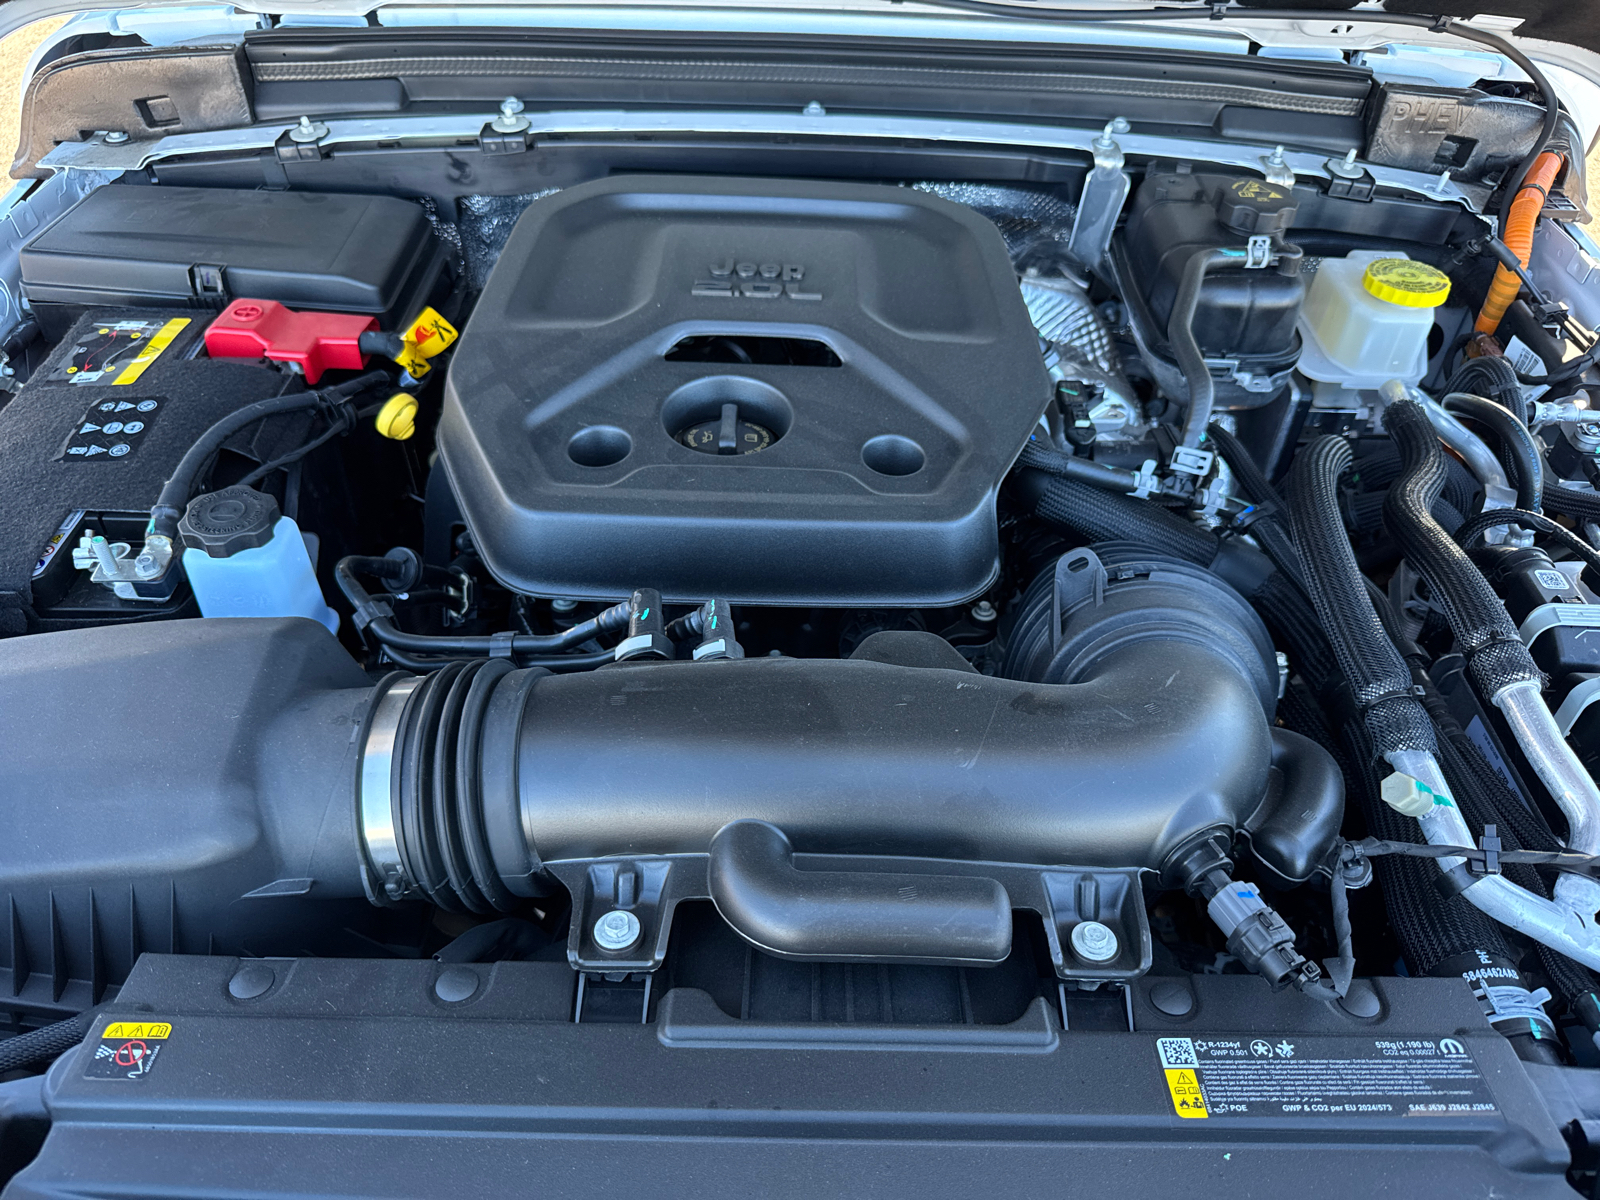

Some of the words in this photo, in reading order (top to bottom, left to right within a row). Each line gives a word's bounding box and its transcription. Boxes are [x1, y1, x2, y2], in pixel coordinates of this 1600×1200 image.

[1384, 101, 1476, 134] PHEV
[709, 259, 805, 280] Jeep
[1518, 431, 1530, 446] HOSE
[1408, 1104, 1427, 1112] SAE
